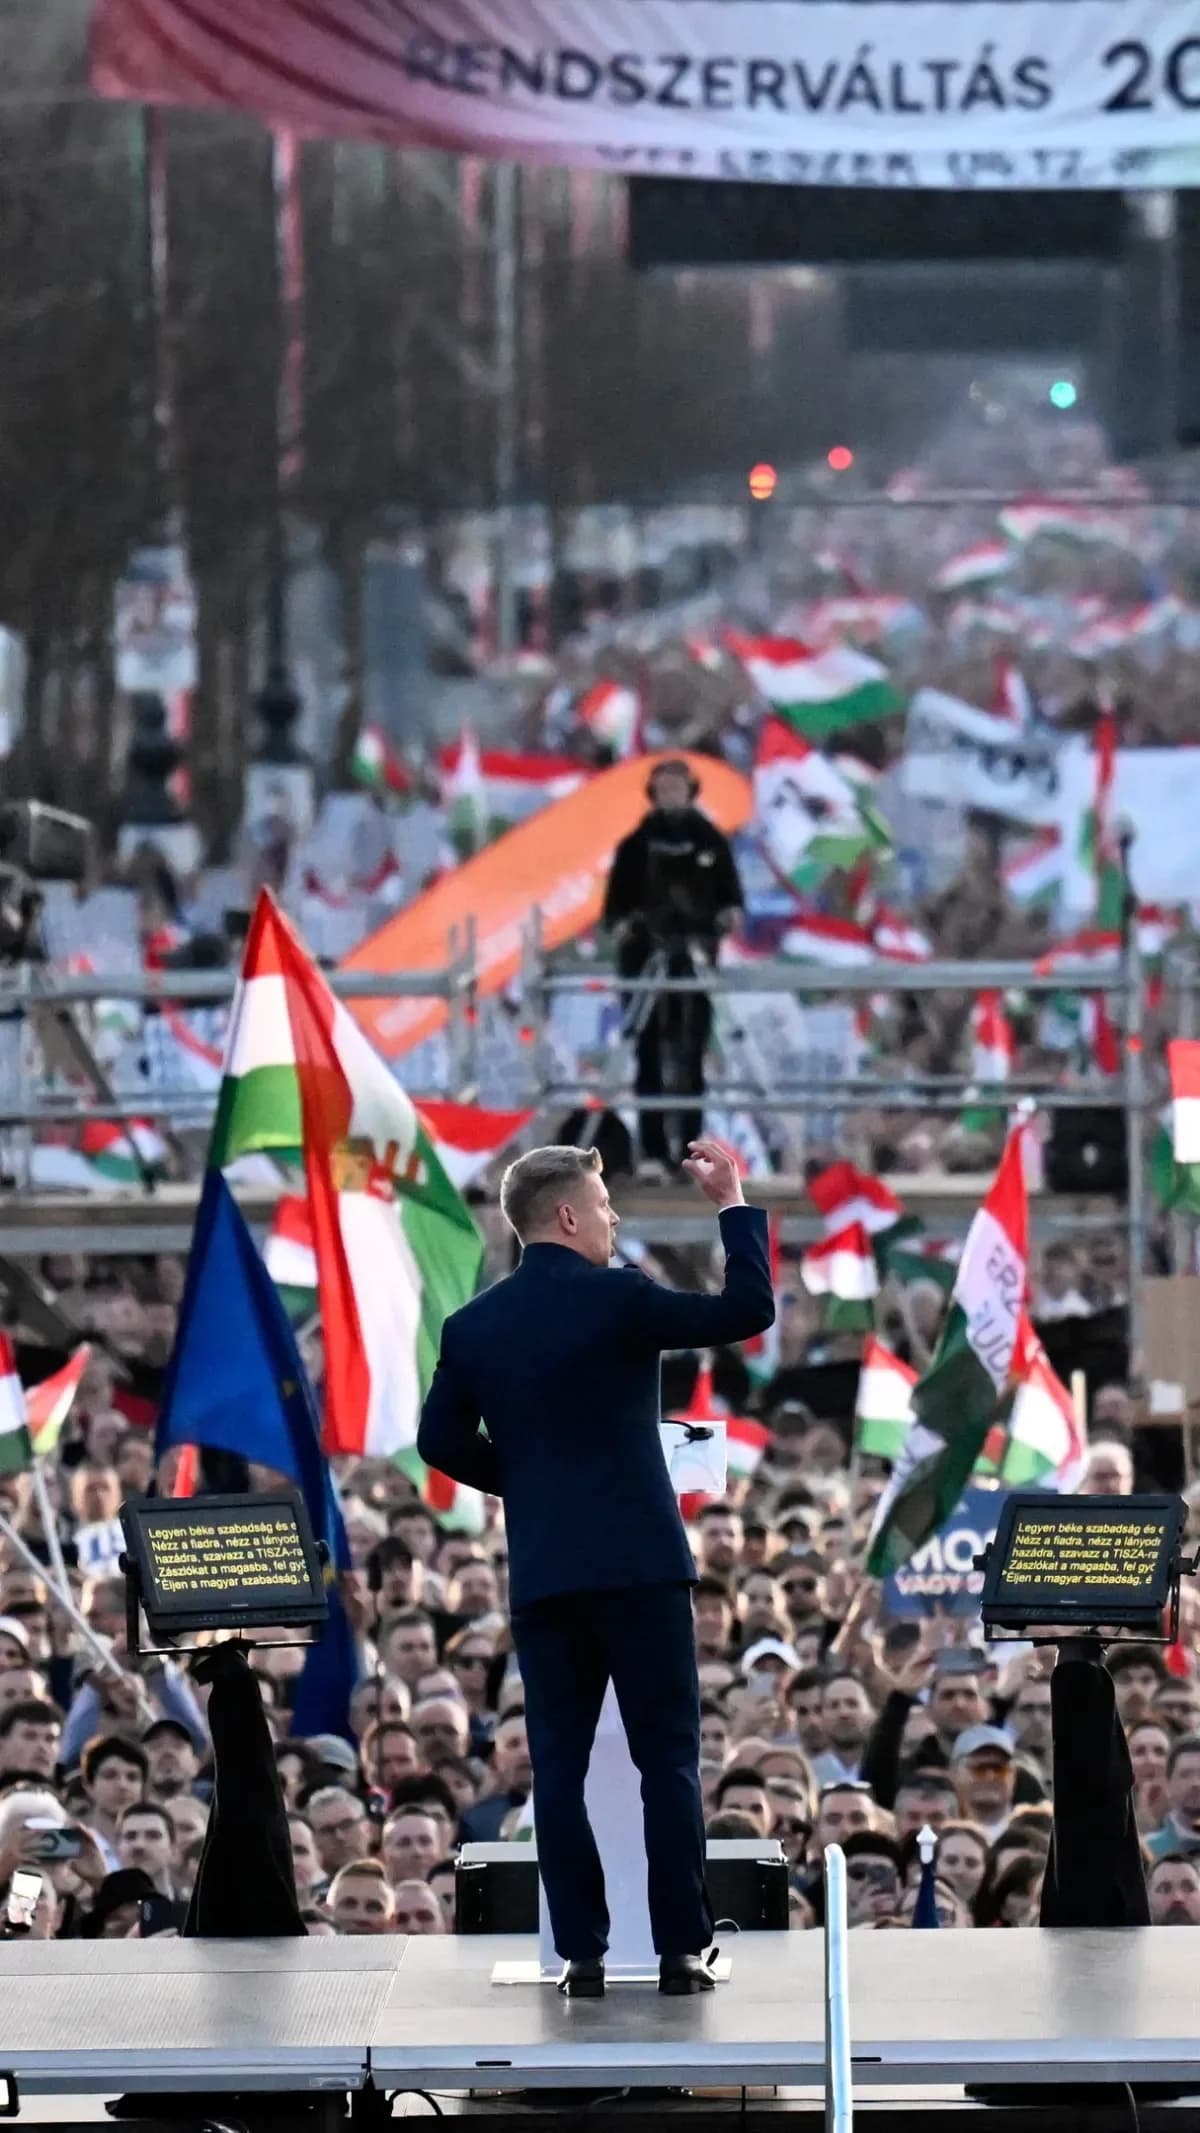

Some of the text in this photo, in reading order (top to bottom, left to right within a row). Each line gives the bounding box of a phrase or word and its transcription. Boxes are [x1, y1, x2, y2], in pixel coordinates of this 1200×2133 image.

[404, 37, 1053, 113] RENDSZERVÁLTÁS
[149, 1527, 187, 1540] Legyen
[189, 1524, 214, 1535] béke
[218, 1520, 273, 1534] szabadság
[275, 1519, 288, 1530] és
[1018, 1522, 1055, 1536] Legyen
[1059, 1522, 1084, 1533] béke
[1086, 1523, 1140, 1537] szabadság
[1143, 1523, 1156, 1534] és
[152, 1539, 179, 1550] Nézz
[182, 1541, 187, 1549] a
[190, 1537, 224, 1548] fiadra,
[226, 1535, 251, 1546] nézz
[253, 1537, 260, 1545] a
[1015, 1534, 1040, 1545] Nézz
[1044, 1537, 1049, 1545] a
[1054, 1534, 1085, 1547] fiadra,
[1088, 1534, 1112, 1545] nézz
[155, 1551, 200, 1563] hazádra,
[204, 1551, 244, 1561] szavazz
[1012, 1547, 1055, 1559] hazádra,
[1059, 1550, 1100, 1558] szavazz
[1103, 1550, 1109, 1558] a
[159, 1563, 208, 1576] Zászlókat
[220, 1560, 270, 1576] magasba,
[274, 1559, 286, 1570] fel
[1009, 1559, 1058, 1570] Zászlókat
[1060, 1562, 1067, 1570] a
[1069, 1560, 1120, 1573] magasba,
[1123, 1560, 1136, 1571] fel
[161, 1578, 189, 1592] Éljen
[190, 1580, 197, 1588] a
[200, 1578, 239, 1590] magyar
[242, 1572, 300, 1586] szabadság,
[1006, 1571, 1032, 1586] Éljen
[1034, 1575, 1041, 1583] a
[1044, 1575, 1082, 1586] magyar
[1085, 1573, 1142, 1587] szabadság,
